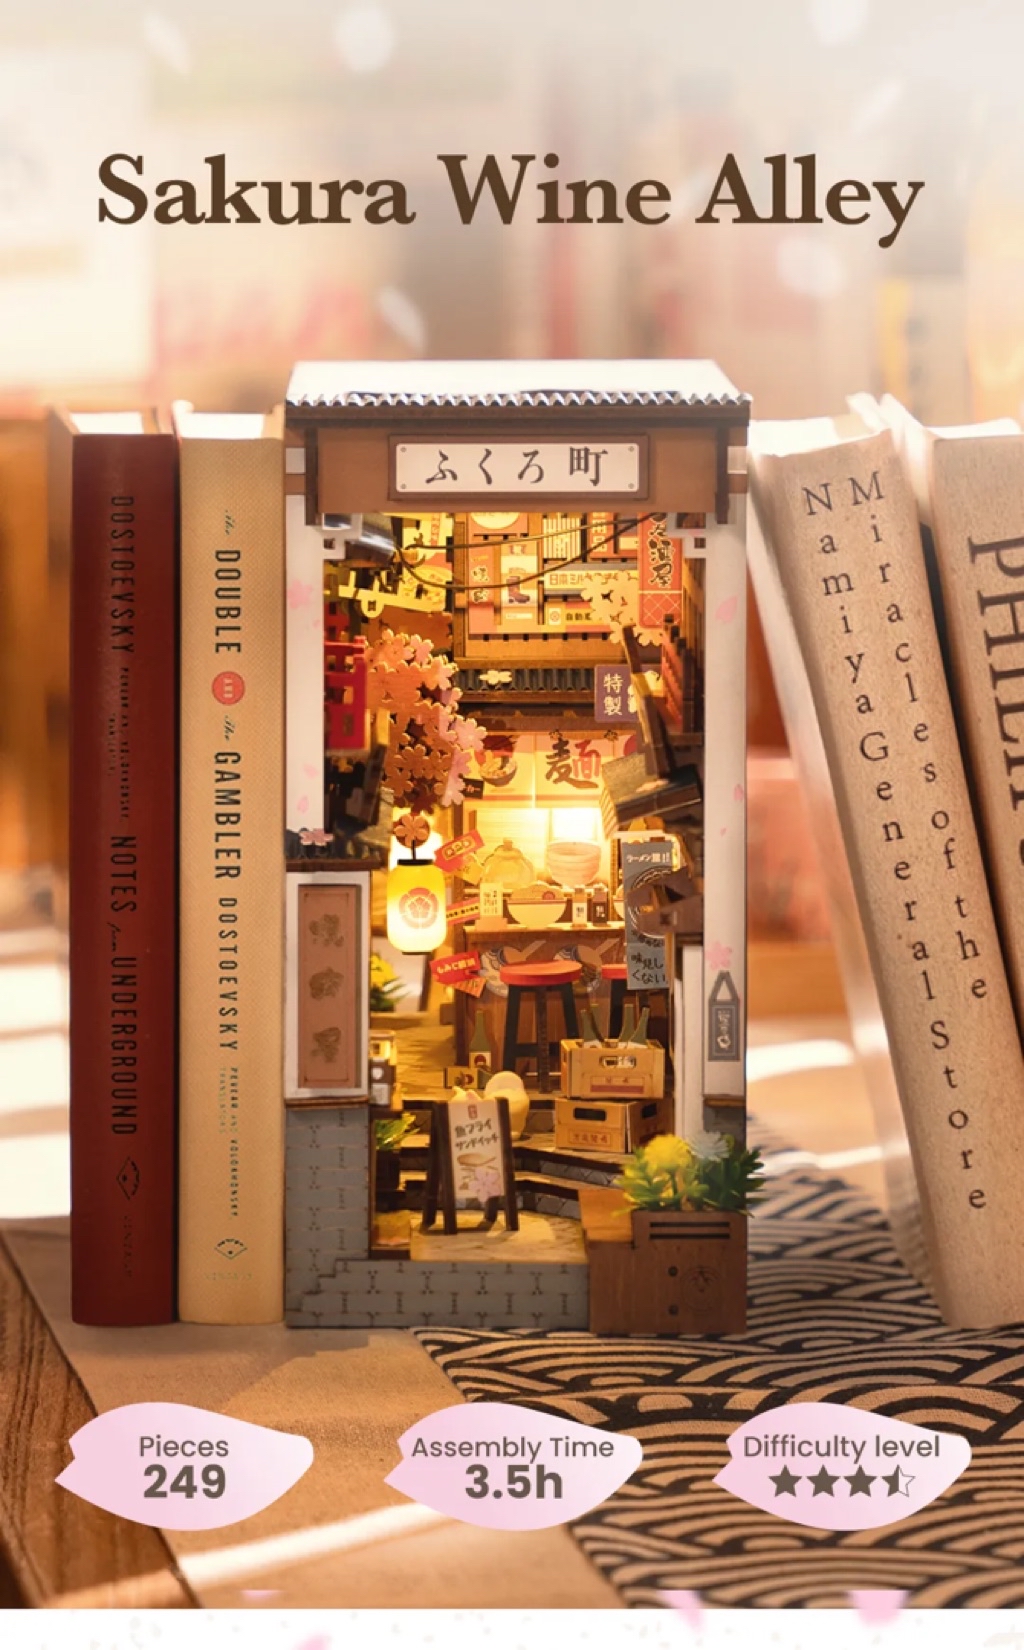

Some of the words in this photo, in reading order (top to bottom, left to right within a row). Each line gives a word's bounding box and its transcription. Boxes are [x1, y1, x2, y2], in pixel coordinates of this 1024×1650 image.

[425, 445, 608, 487] ふくろ町
[224, 509, 236, 536] The
[110, 496, 136, 654] DOSTOEVSKY
[214, 549, 242, 655] DOUBLE
[222, 677, 235, 699] AND
[603, 673, 623, 716] 特製
[223, 714, 236, 742] The
[847, 470, 938, 784] Miracles
[930, 810, 958, 870] of
[954, 895, 988, 999] the
[214, 751, 242, 879] GAMBLER
[111, 835, 138, 914] NOTES
[106, 922, 122, 953] from
[218, 896, 239, 1051] DOSTOEVSKY
[110, 956, 138, 1135] UNDERGROUND
[230, 1067, 239, 1109] PEVEAR
[929, 1020, 987, 1209] Store
